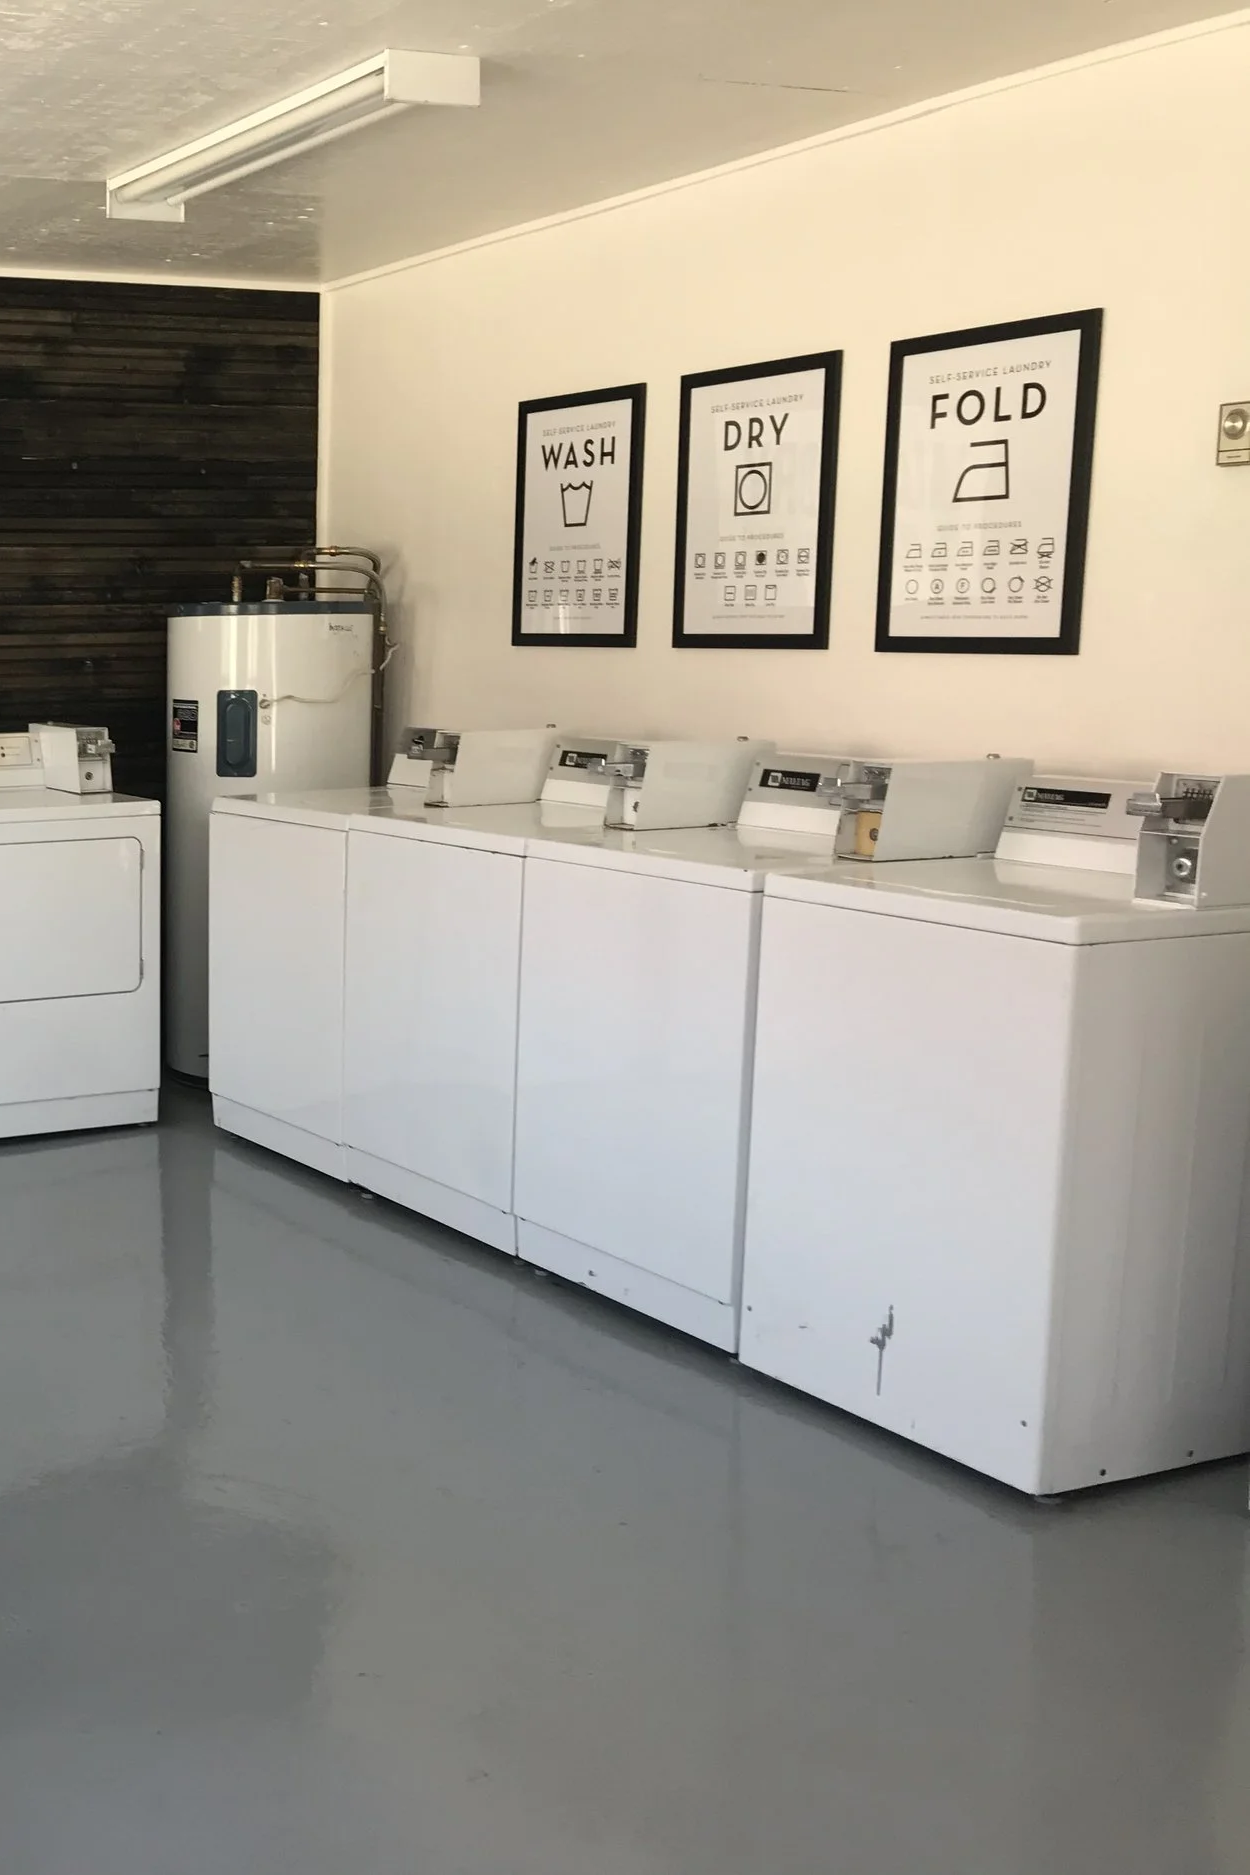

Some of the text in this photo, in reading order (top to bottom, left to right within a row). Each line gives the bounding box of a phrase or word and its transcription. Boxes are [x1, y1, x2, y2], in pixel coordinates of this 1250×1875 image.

[929, 360, 1052, 385] SELF-SERVICE LAUNDRY
[766, 394, 804, 407] LAUNDRY
[930, 382, 1047, 429] FOLD
[724, 413, 790, 451] DRY
[541, 436, 616, 471] WASH
